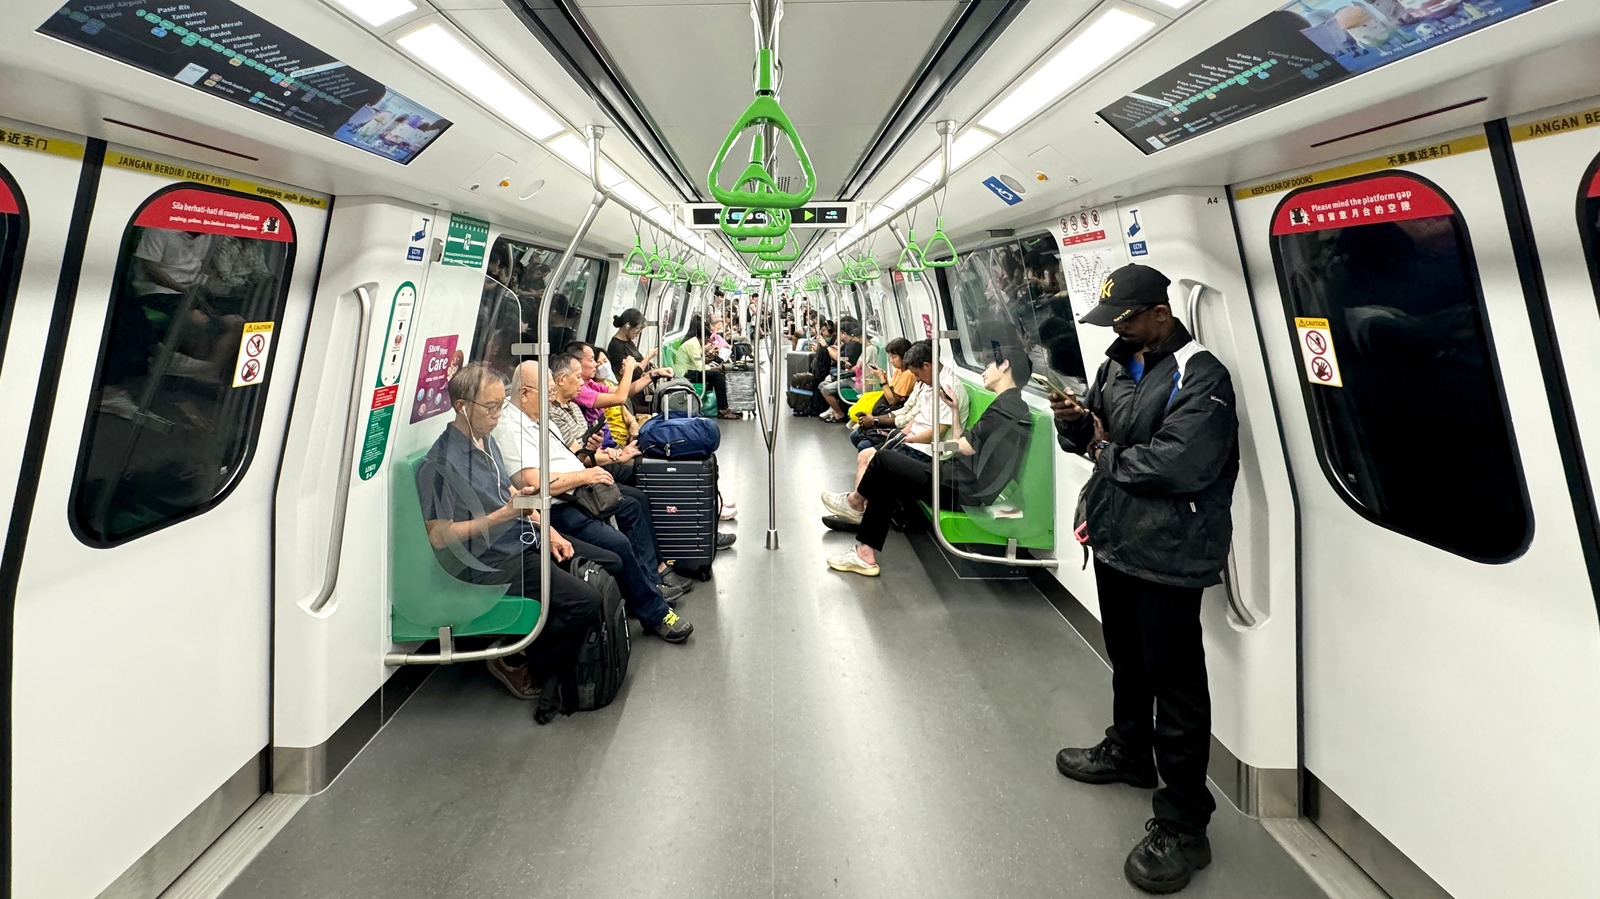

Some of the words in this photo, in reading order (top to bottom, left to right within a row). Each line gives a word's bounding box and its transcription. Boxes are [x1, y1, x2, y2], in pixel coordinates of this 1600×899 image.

[157, 6, 177, 14] Pasir
[171, 10, 208, 20] Tampines
[185, 18, 206, 26] Simei
[198, 24, 220, 32] Tanah
[220, 20, 242, 28] Merah
[210, 30, 232, 38] Bedok
[222, 33, 261, 44] Kembangan
[255, 50, 280, 59] Aljunied
[1528, 116, 1580, 136] JANGAN
[1387, 144, 1451, 166] 不要靠近车门
[118, 156, 152, 170] JANGAN
[154, 164, 184, 178] BERDIRI
[186, 170, 210, 182] DEKAT
[210, 176, 230, 187] PINTU
[1251, 187, 1265, 195] KEEP
[1265, 183, 1284, 192] CLEAR
[1283, 180, 1292, 188] OF
[1292, 175, 1314, 186] DOORS
[1207, 196, 1218, 204] A4
[1311, 203, 1332, 212] Please
[1332, 199, 1350, 209] mind
[1350, 197, 1362, 206] the
[1362, 192, 1396, 206] platform
[1396, 190, 1412, 200] gap
[172, 202, 184, 210] Sila
[184, 204, 218, 216] berhati-hati
[218, 208, 224, 216] di
[224, 211, 238, 220] ruang
[238, 212, 260, 221] platform
[428, 345, 440, 353] Show
[428, 356, 448, 373] Care
